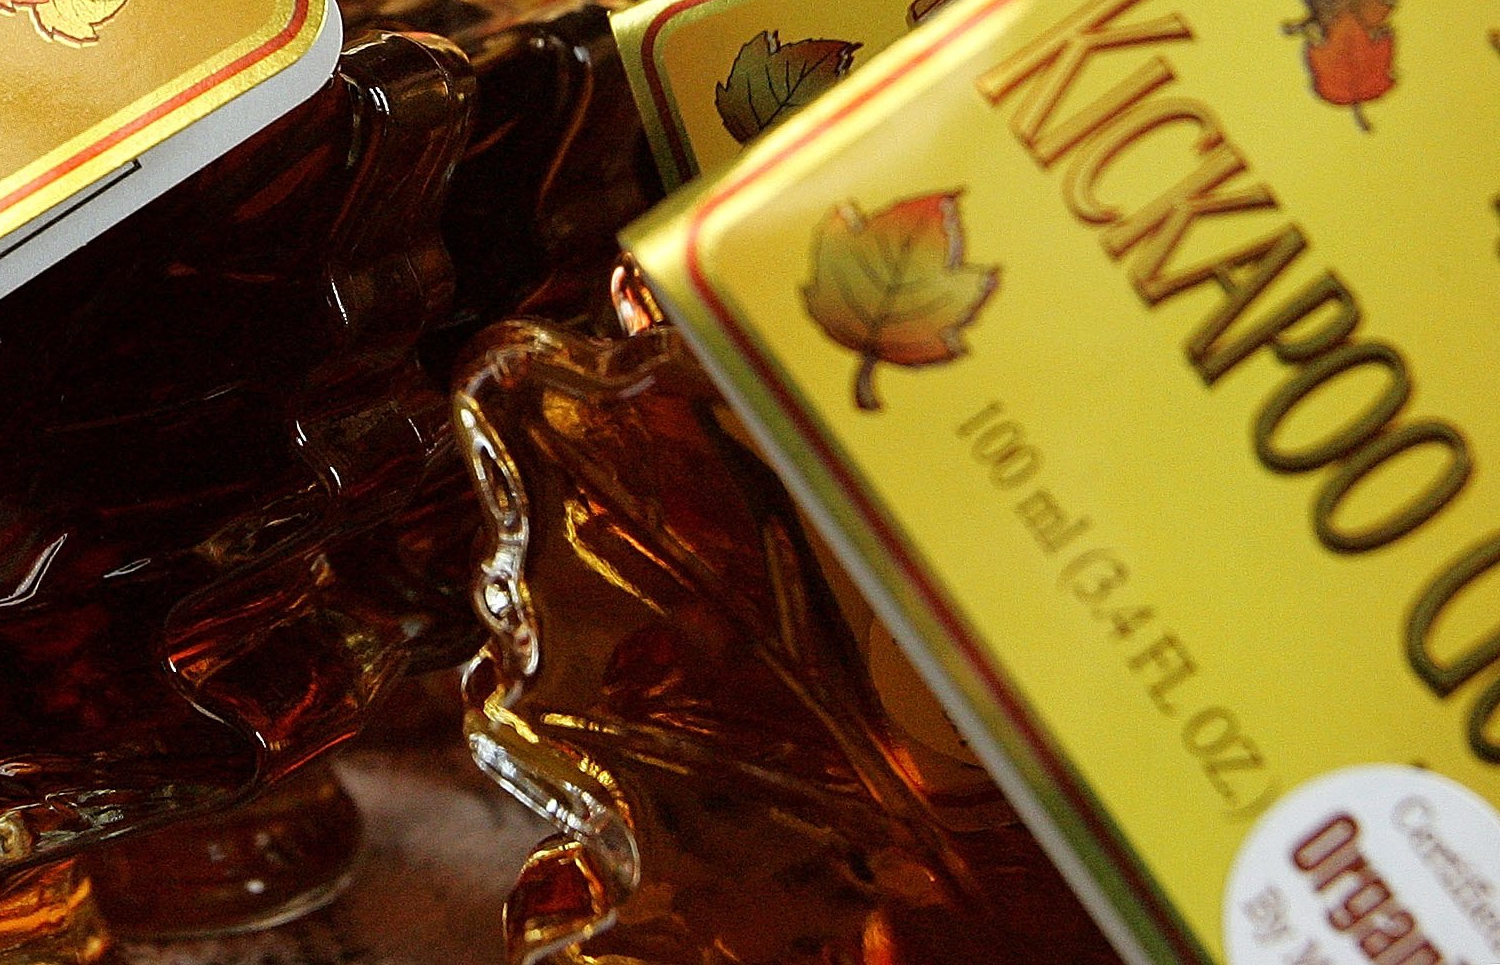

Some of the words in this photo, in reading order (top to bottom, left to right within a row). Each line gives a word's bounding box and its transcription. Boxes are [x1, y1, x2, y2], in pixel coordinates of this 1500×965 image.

[955, 401, 1044, 491] 100
[1014, 489, 1093, 555] ml
[1127, 632, 1199, 717] FL
